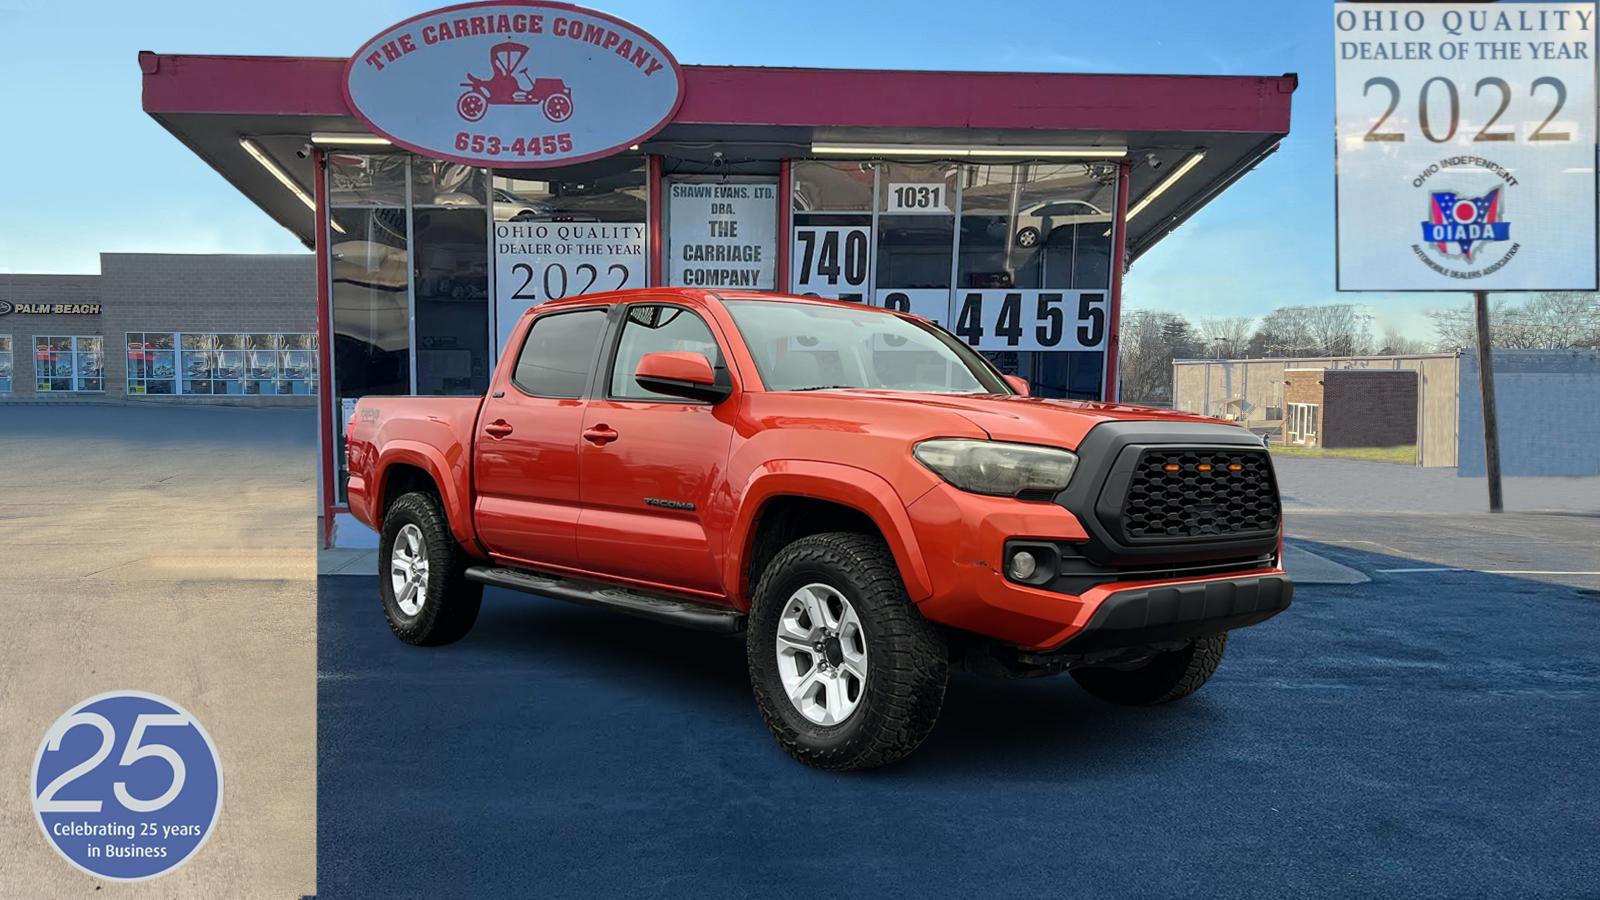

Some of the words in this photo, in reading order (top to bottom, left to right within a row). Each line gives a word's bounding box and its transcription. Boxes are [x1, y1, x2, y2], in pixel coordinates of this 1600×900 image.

[1336, 10, 1425, 32] OHIO
[1442, 10, 1593, 36] QUALITY
[365, 33, 417, 72] THE
[422, 14, 543, 45] CARRIAGE
[553, 16, 664, 77] COMPANY
[1340, 42, 1433, 60] DEALER
[1439, 42, 1469, 60] OF
[1475, 42, 1522, 60] THE
[1528, 42, 1589, 60] YEAR
[1362, 76, 1571, 143] 2022
[454, 132, 573, 156] 653-4455
[1412, 163, 1439, 188] OHIO
[1440, 155, 1519, 187] INDEPENDENT
[672, 186, 712, 198] SHAWN
[754, 187, 775, 199] LTD.
[894, 186, 940, 208] 1031
[711, 203, 736, 215] DBA.
[497, 226, 548, 239] OHIO
[558, 226, 644, 240] QUALITY
[708, 220, 738, 238] THE
[1432, 224, 1495, 240] OIADA
[500, 244, 552, 255] DEALER
[555, 244, 573, 255] OF
[576, 244, 603, 255] THE
[606, 244, 642, 255] YEAR
[683, 245, 762, 262] CARRIAGE
[797, 230, 868, 286] 740
[511, 263, 630, 300] 2022
[683, 268, 760, 286] COMPANY
[15, 304, 51, 314] PALM
[54, 304, 101, 314] BEACH
[644, 497, 696, 511] TACOMA
